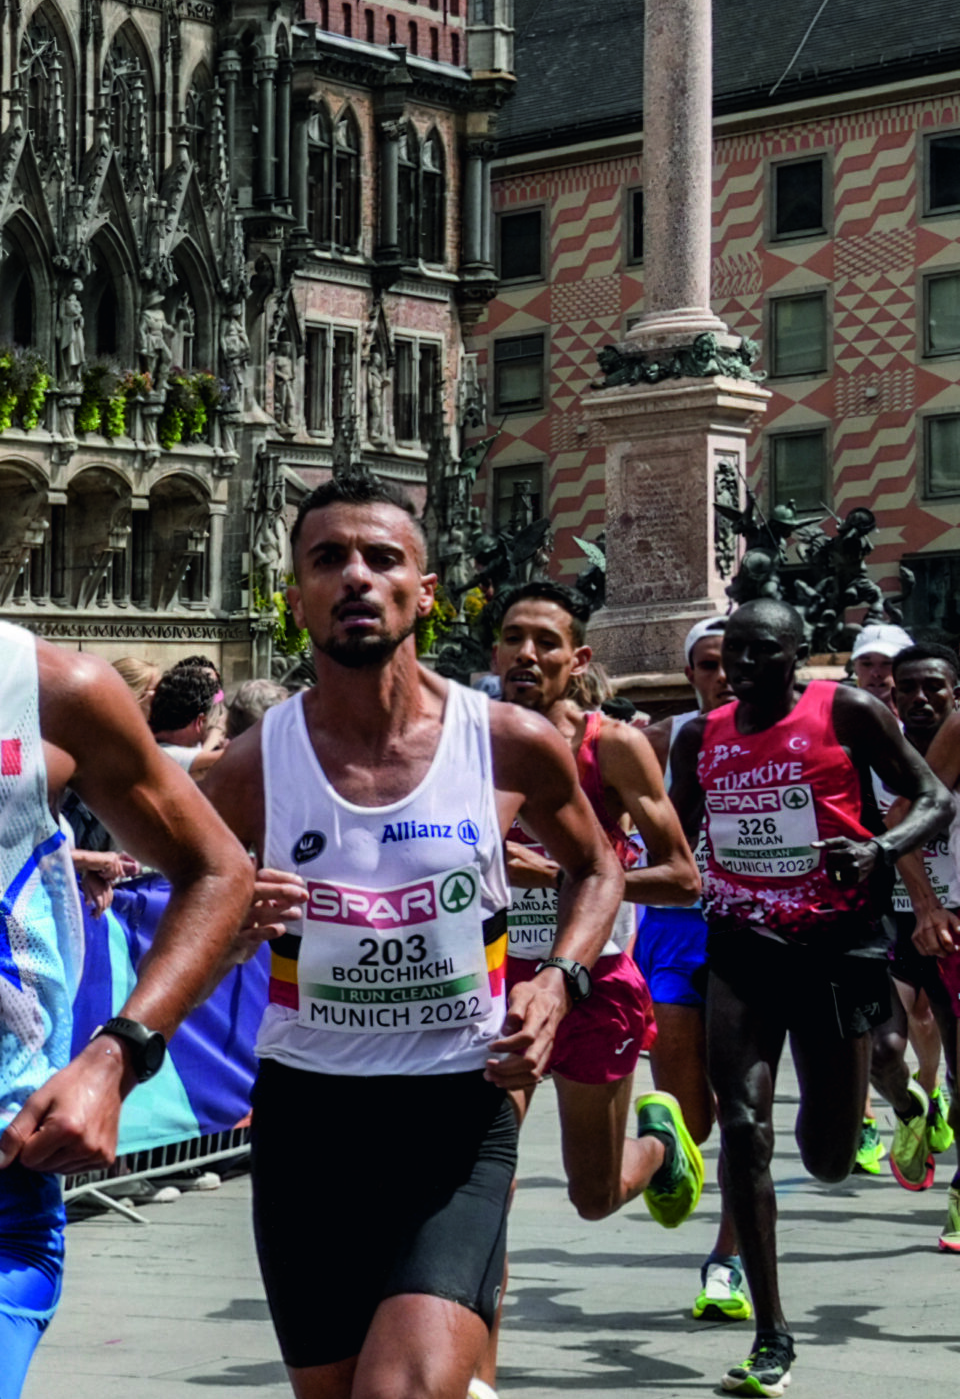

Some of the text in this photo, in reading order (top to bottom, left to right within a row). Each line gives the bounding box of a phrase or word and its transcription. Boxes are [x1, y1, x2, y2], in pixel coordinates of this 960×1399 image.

[708, 792, 778, 811] SPAR
[381, 821, 453, 844] Allianz
[738, 818, 777, 836] 326
[722, 858, 814, 873] MUNICH 2022
[310, 888, 433, 923] SPAR
[357, 934, 427, 966] 203
[332, 957, 455, 984] BOUCHIKHI
[350, 988, 385, 1003] RUN
[311, 996, 482, 1027] MUNICH 2022
